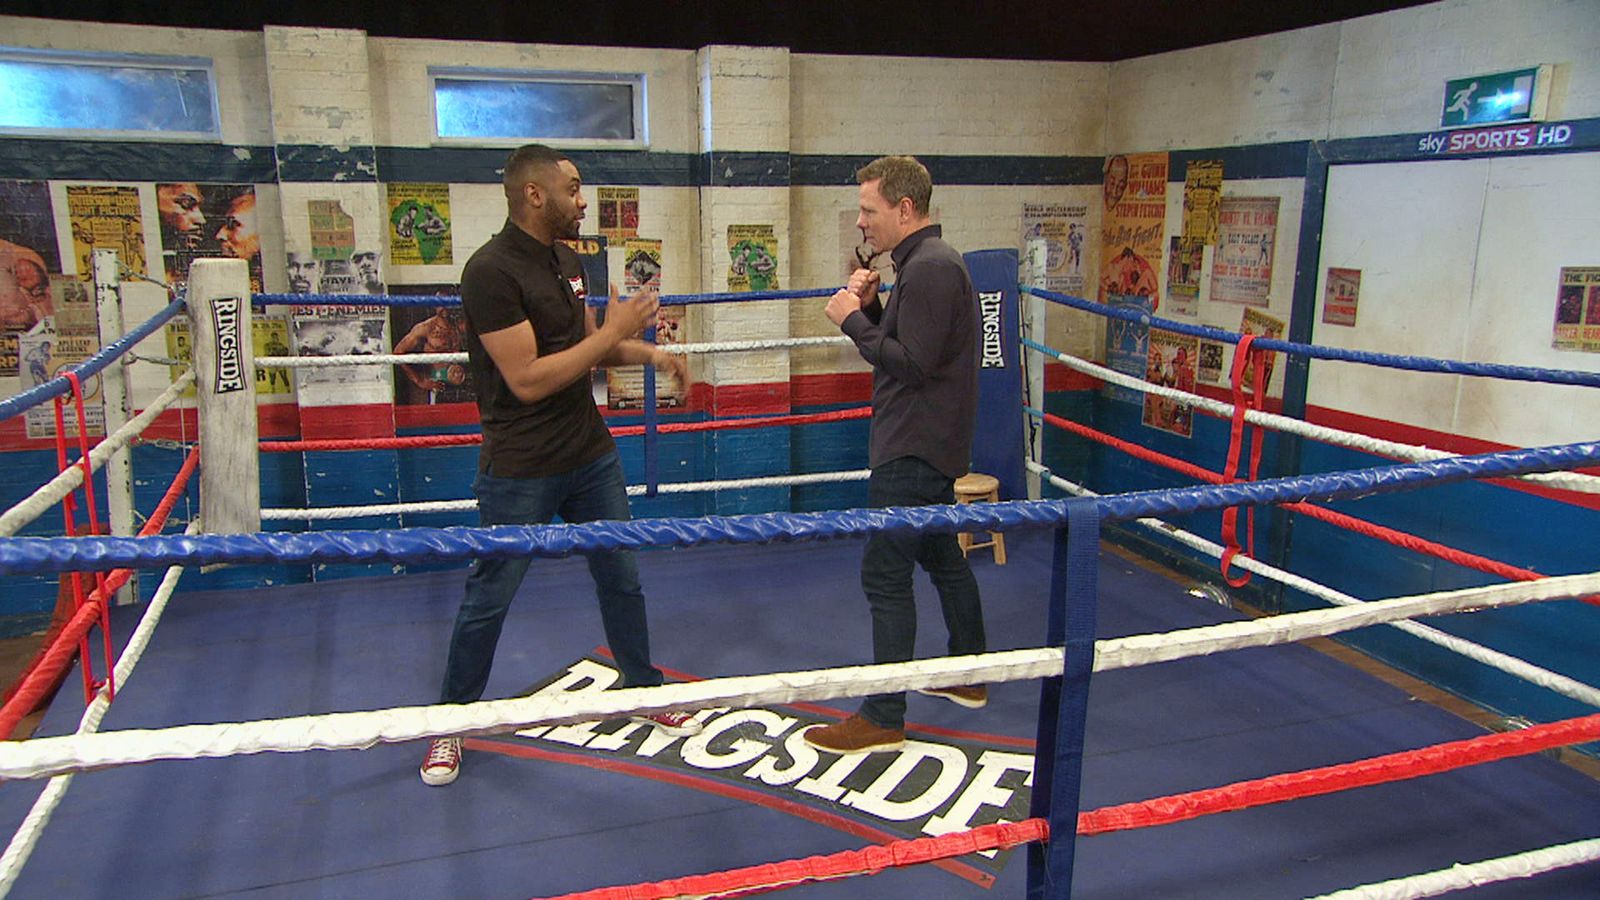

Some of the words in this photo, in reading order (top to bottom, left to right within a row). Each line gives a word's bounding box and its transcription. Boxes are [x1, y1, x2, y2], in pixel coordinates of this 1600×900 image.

[1418, 134, 1446, 153] sky
[1450, 128, 1530, 150] SPORTS
[1537, 125, 1572, 144] HD
[1564, 273, 1583, 283] THE
[213, 297, 244, 393] RINGSIDE
[978, 290, 1005, 368] RINGSIDE
